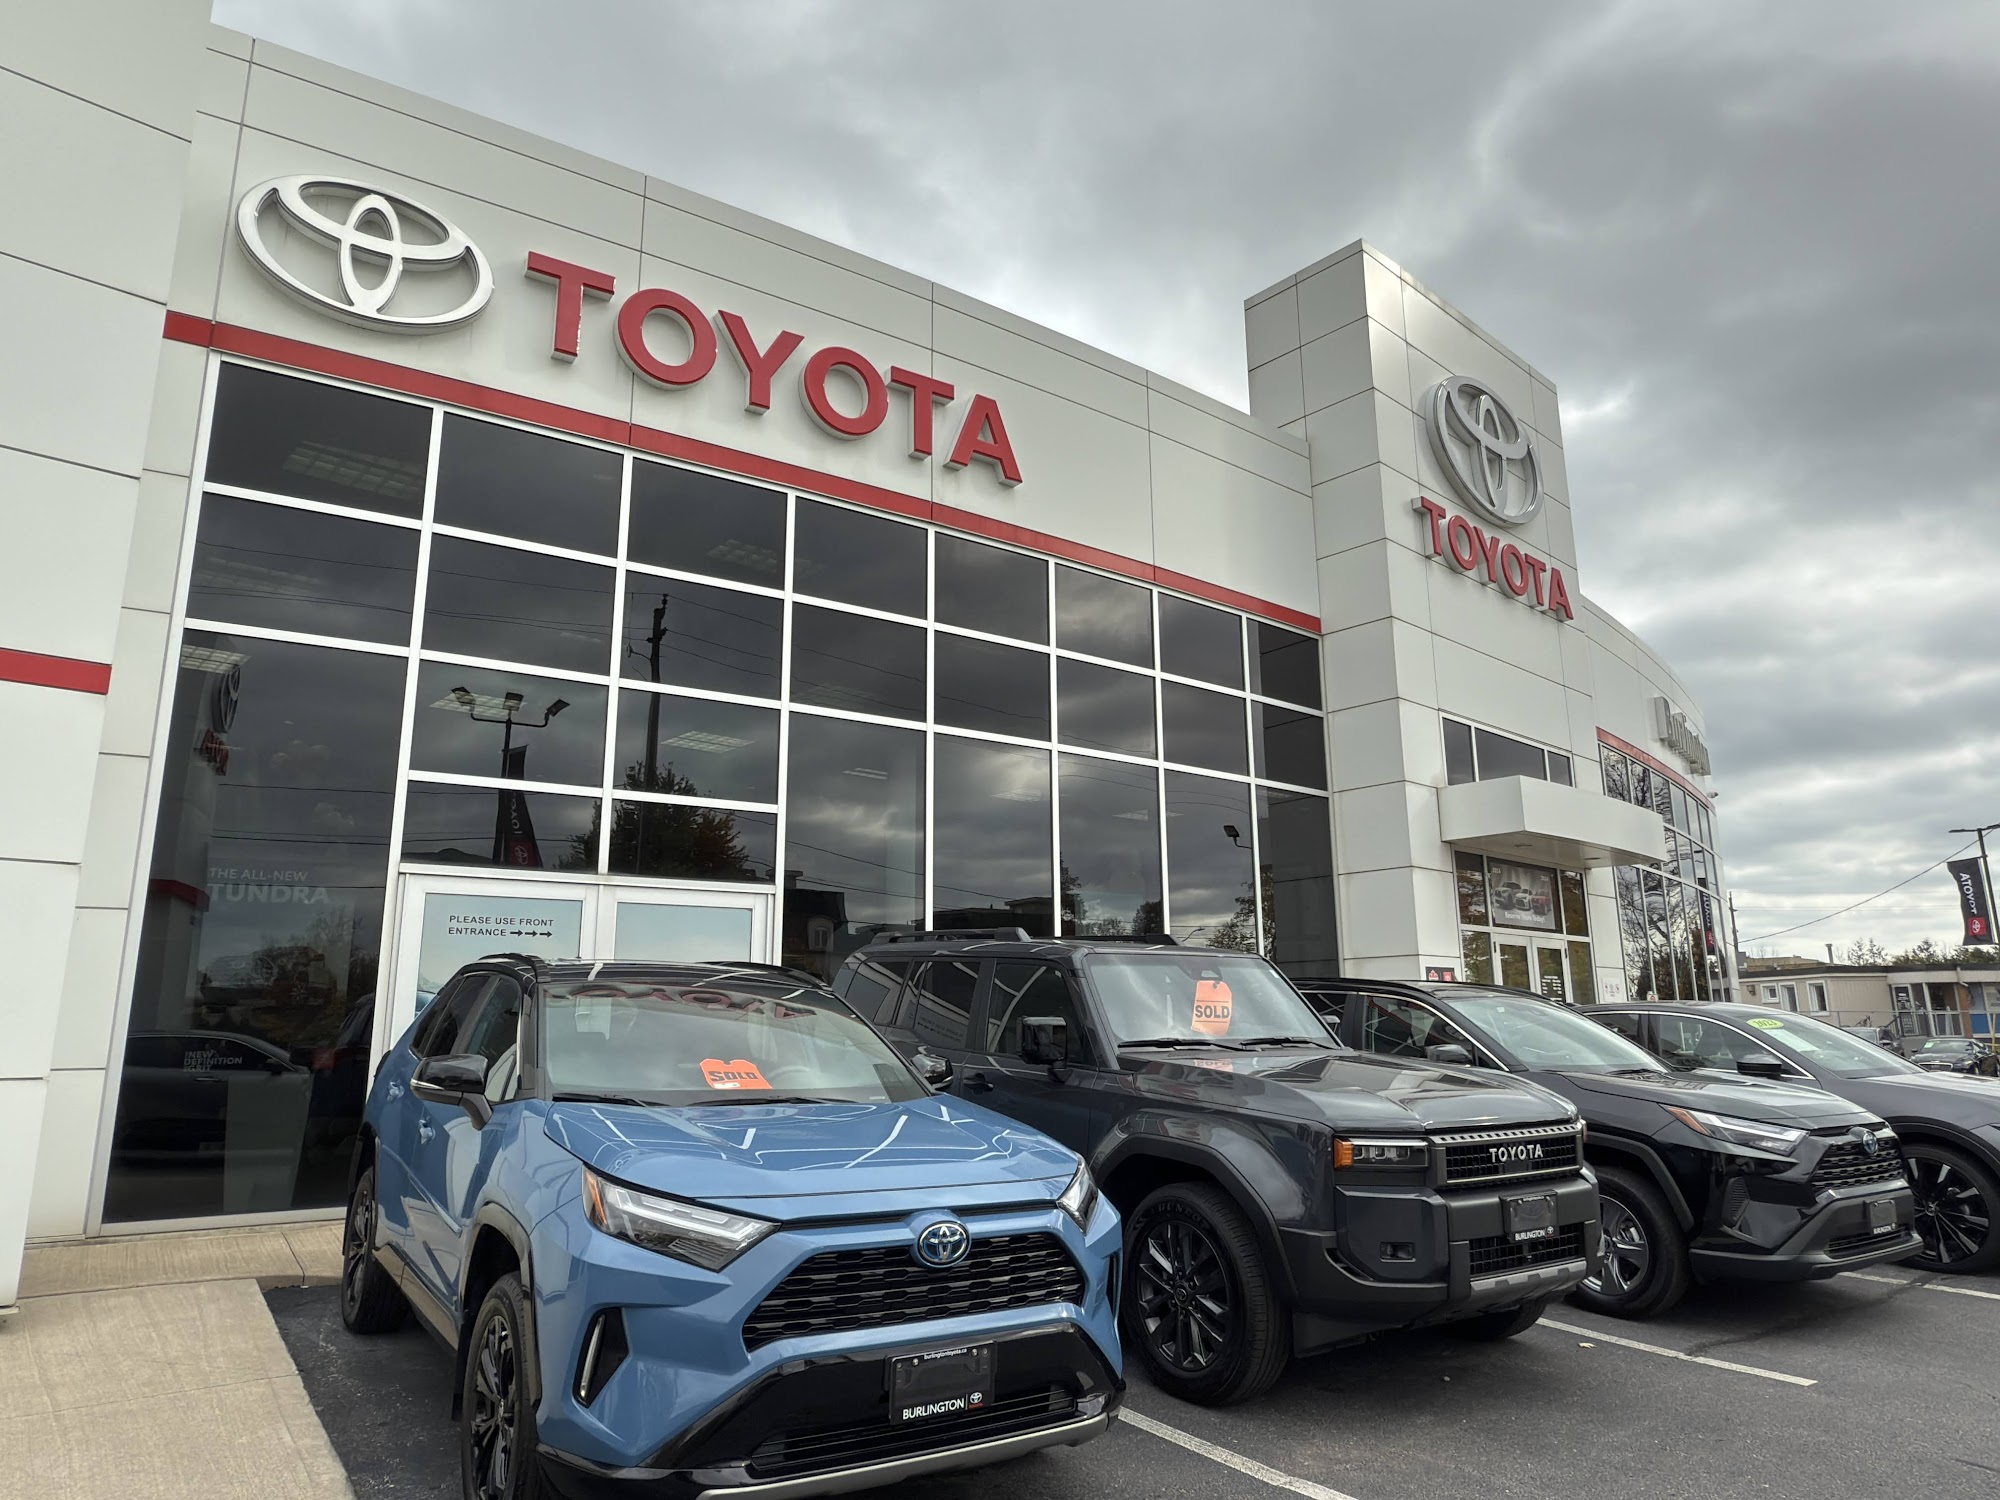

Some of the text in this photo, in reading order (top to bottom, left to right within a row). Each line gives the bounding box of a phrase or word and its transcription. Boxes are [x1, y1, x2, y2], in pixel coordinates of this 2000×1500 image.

[525, 251, 1023, 488] TOYOTA
[1412, 496, 1574, 622] TOYOTA
[209, 868, 307, 882] THE ALL-NEW
[207, 883, 330, 904] TUNDRA
[449, 915, 554, 927] PLEASE USE FRONT
[448, 927, 507, 936] ENTRANCE
[1195, 1005, 1230, 1018] SOLD
[184, 1056, 243, 1065] DEFINITION
[708, 1071, 759, 1082] SOLD
[1489, 1144, 1543, 1162] TOYOTA
[1515, 1229, 1546, 1241] BURLINGTON
[903, 1398, 965, 1420] BURLINGTON
